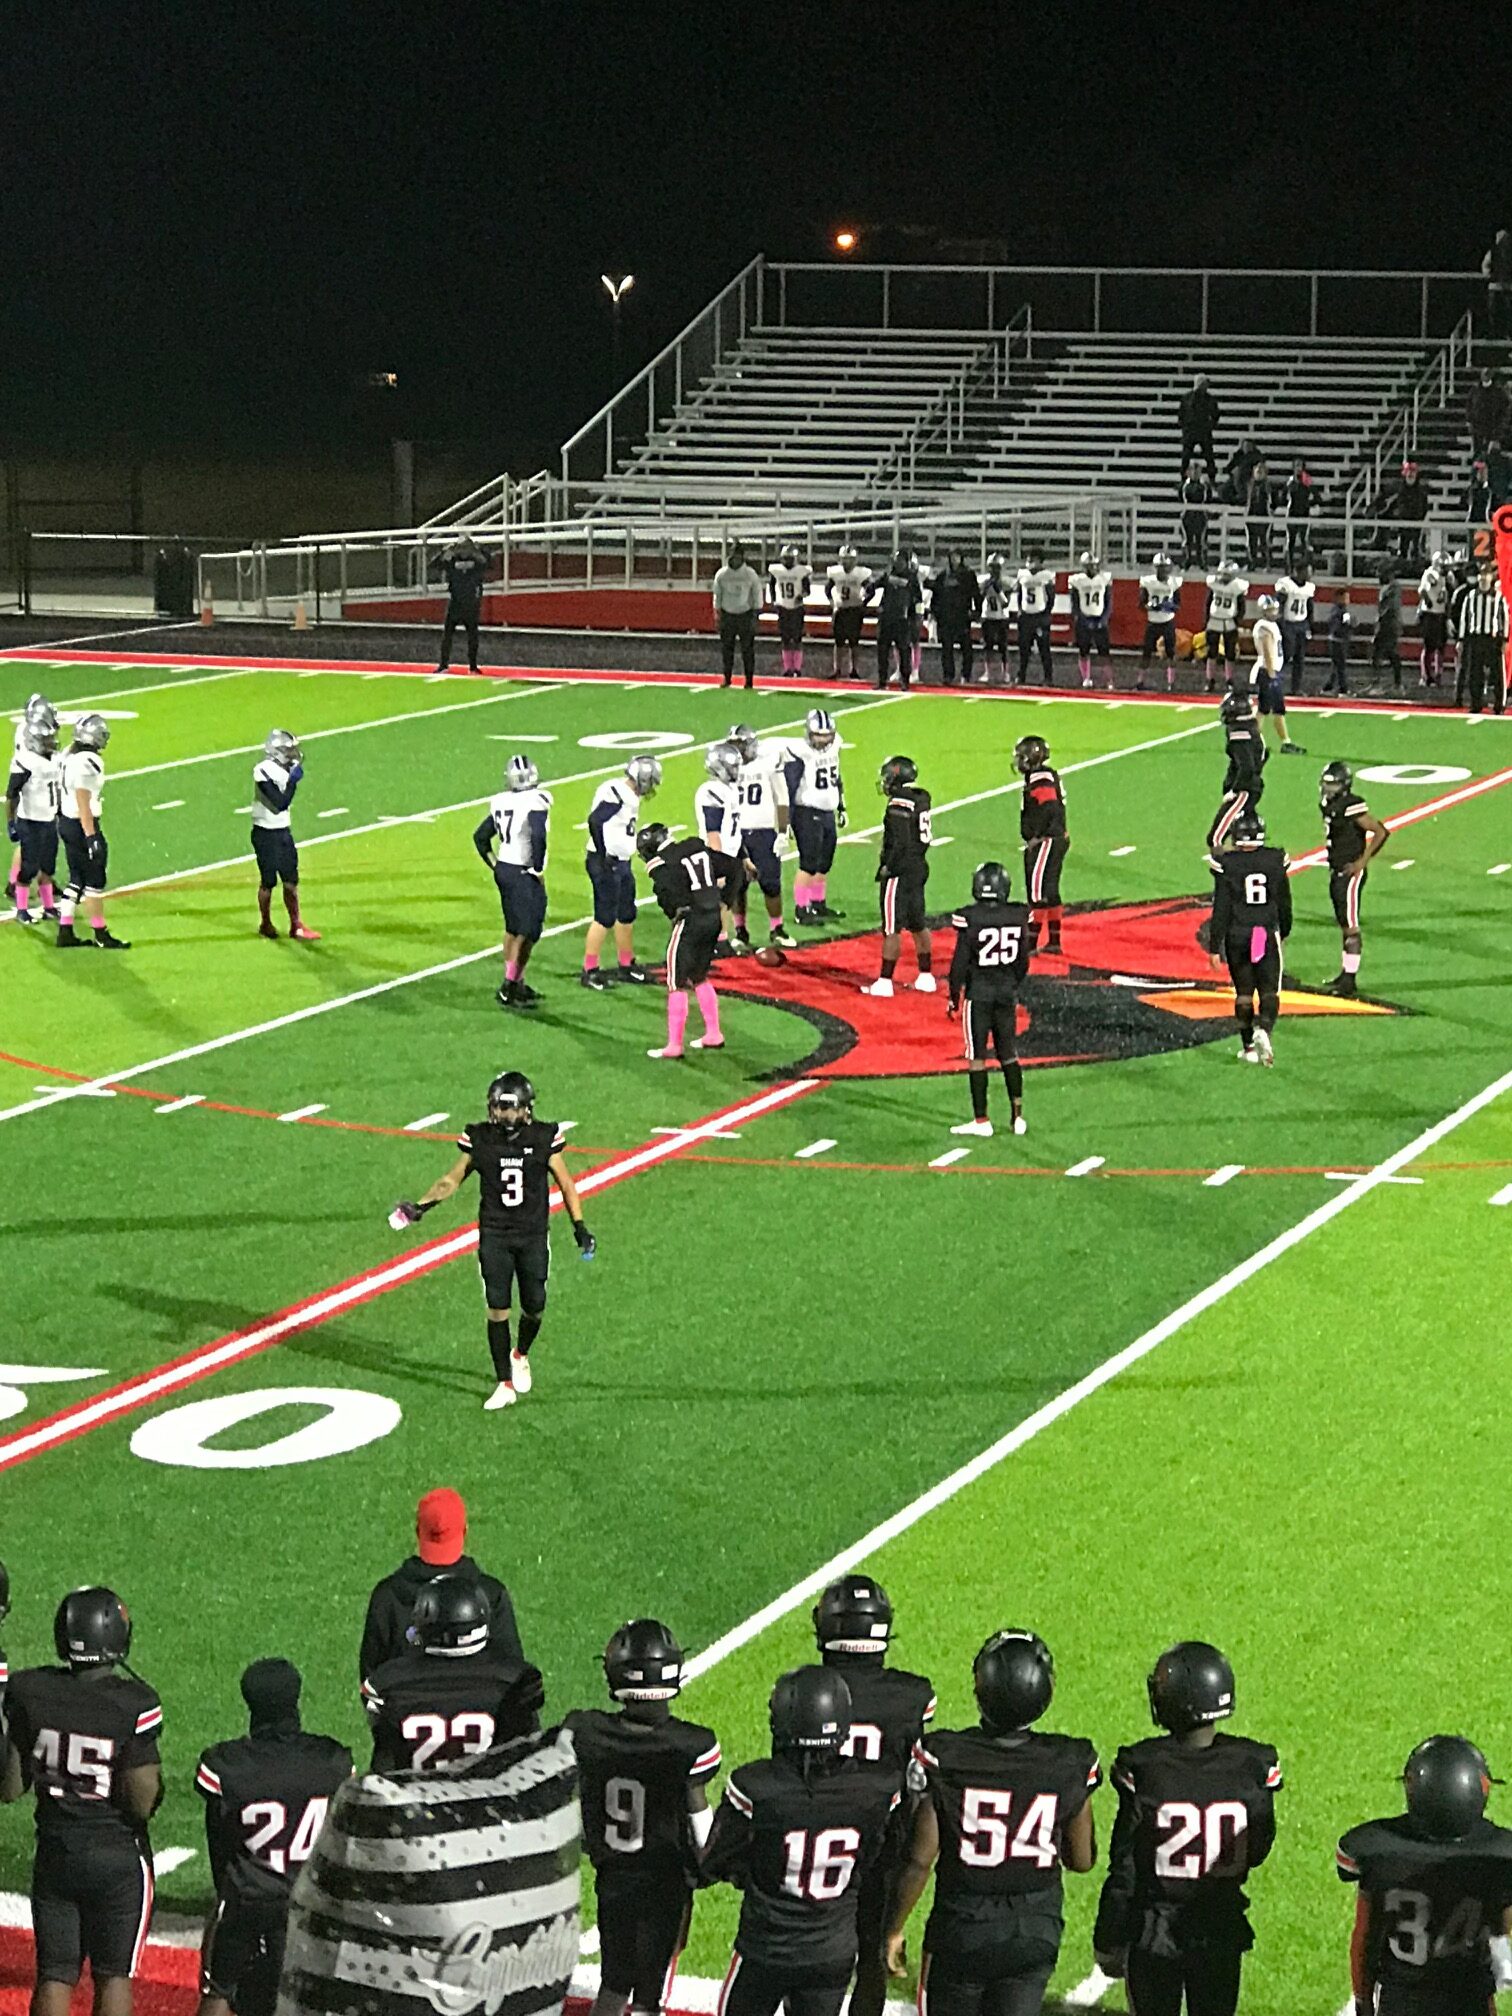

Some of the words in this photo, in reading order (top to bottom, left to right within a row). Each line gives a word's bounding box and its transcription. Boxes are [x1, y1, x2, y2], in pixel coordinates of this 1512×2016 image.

[1474, 530, 1490, 557] 2
[780, 583, 795, 598] 19
[1026, 587, 1036, 604] 5
[1084, 592, 1100, 606] 14
[681, 851, 713, 891] 17
[1245, 873, 1267, 904] 6
[978, 927, 1021, 966] 25
[500, 1168, 523, 1207] 3
[401, 1712, 495, 1771] 23
[605, 1776, 646, 1853] 9
[958, 1786, 1059, 1869] 54
[240, 1796, 330, 1874] 24
[1154, 1801, 1249, 1879] 20
[779, 1826, 861, 1900] 16
